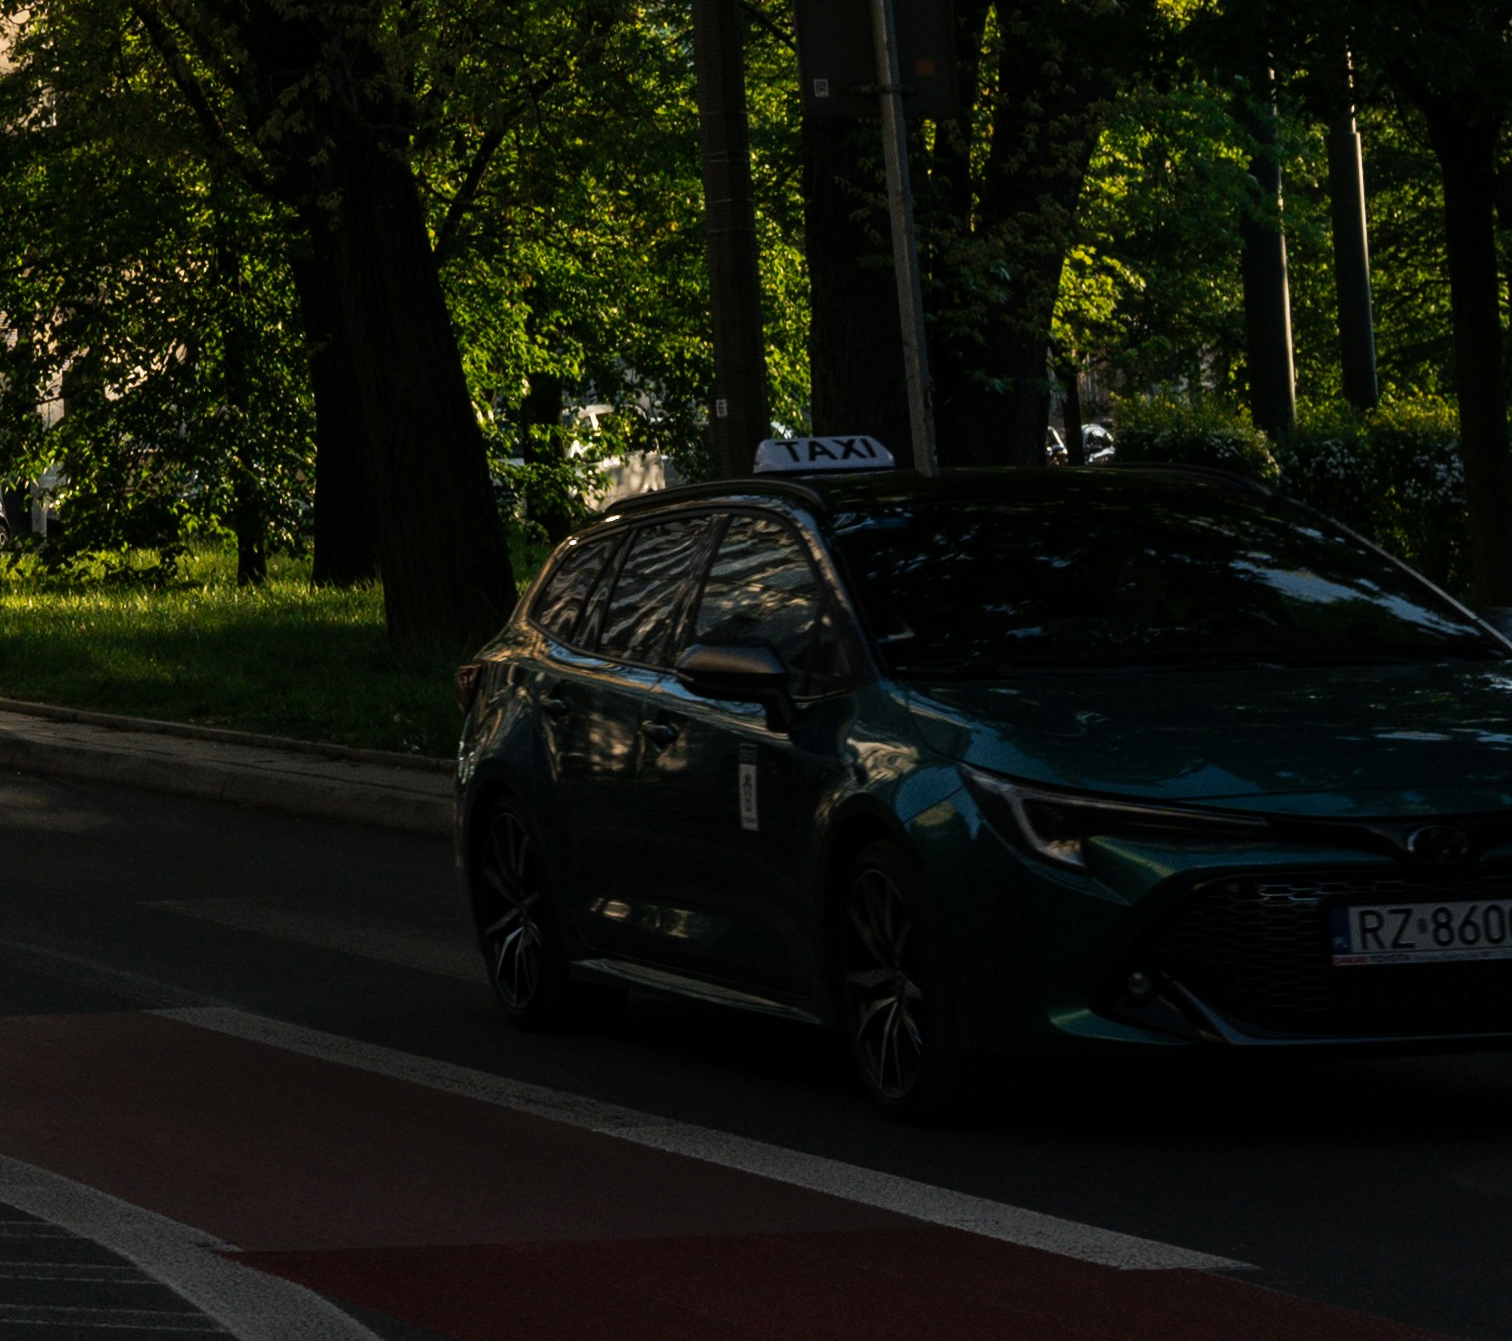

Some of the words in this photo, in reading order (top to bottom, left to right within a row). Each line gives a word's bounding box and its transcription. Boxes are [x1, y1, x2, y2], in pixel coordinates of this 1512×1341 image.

[775, 438, 877, 462] TAXI
[1358, 909, 1415, 949] RZ
[1432, 905, 1512, 946] 860
